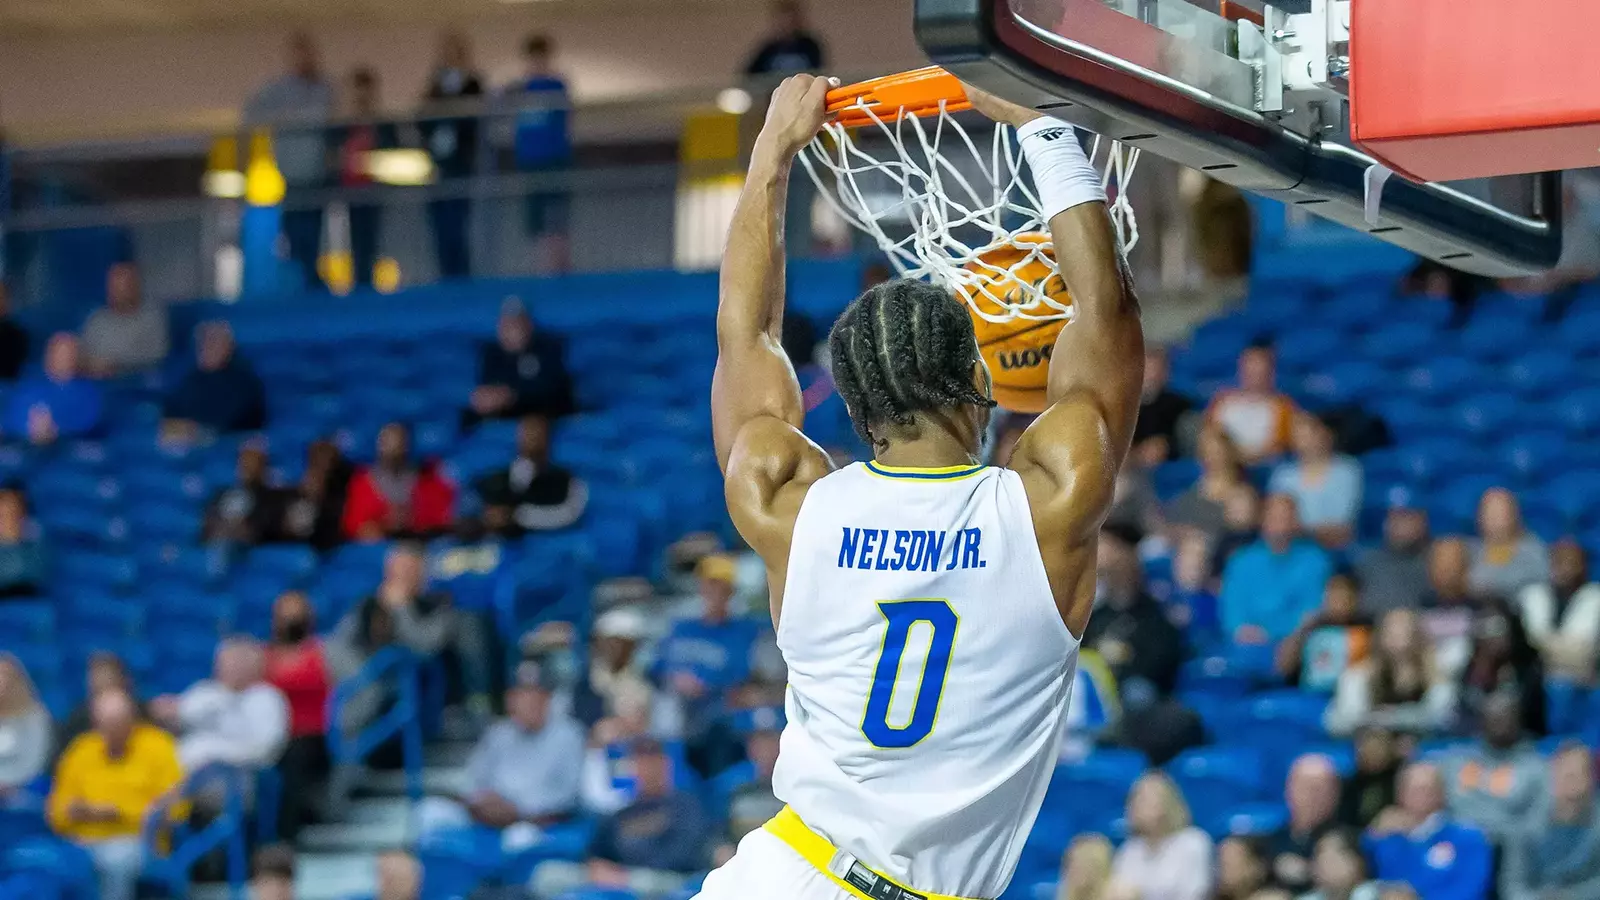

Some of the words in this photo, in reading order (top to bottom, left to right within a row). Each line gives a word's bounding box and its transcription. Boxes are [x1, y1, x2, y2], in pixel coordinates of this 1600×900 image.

[838, 527, 946, 572] NELSON
[946, 527, 987, 570] JR.
[859, 598, 960, 750] 0
